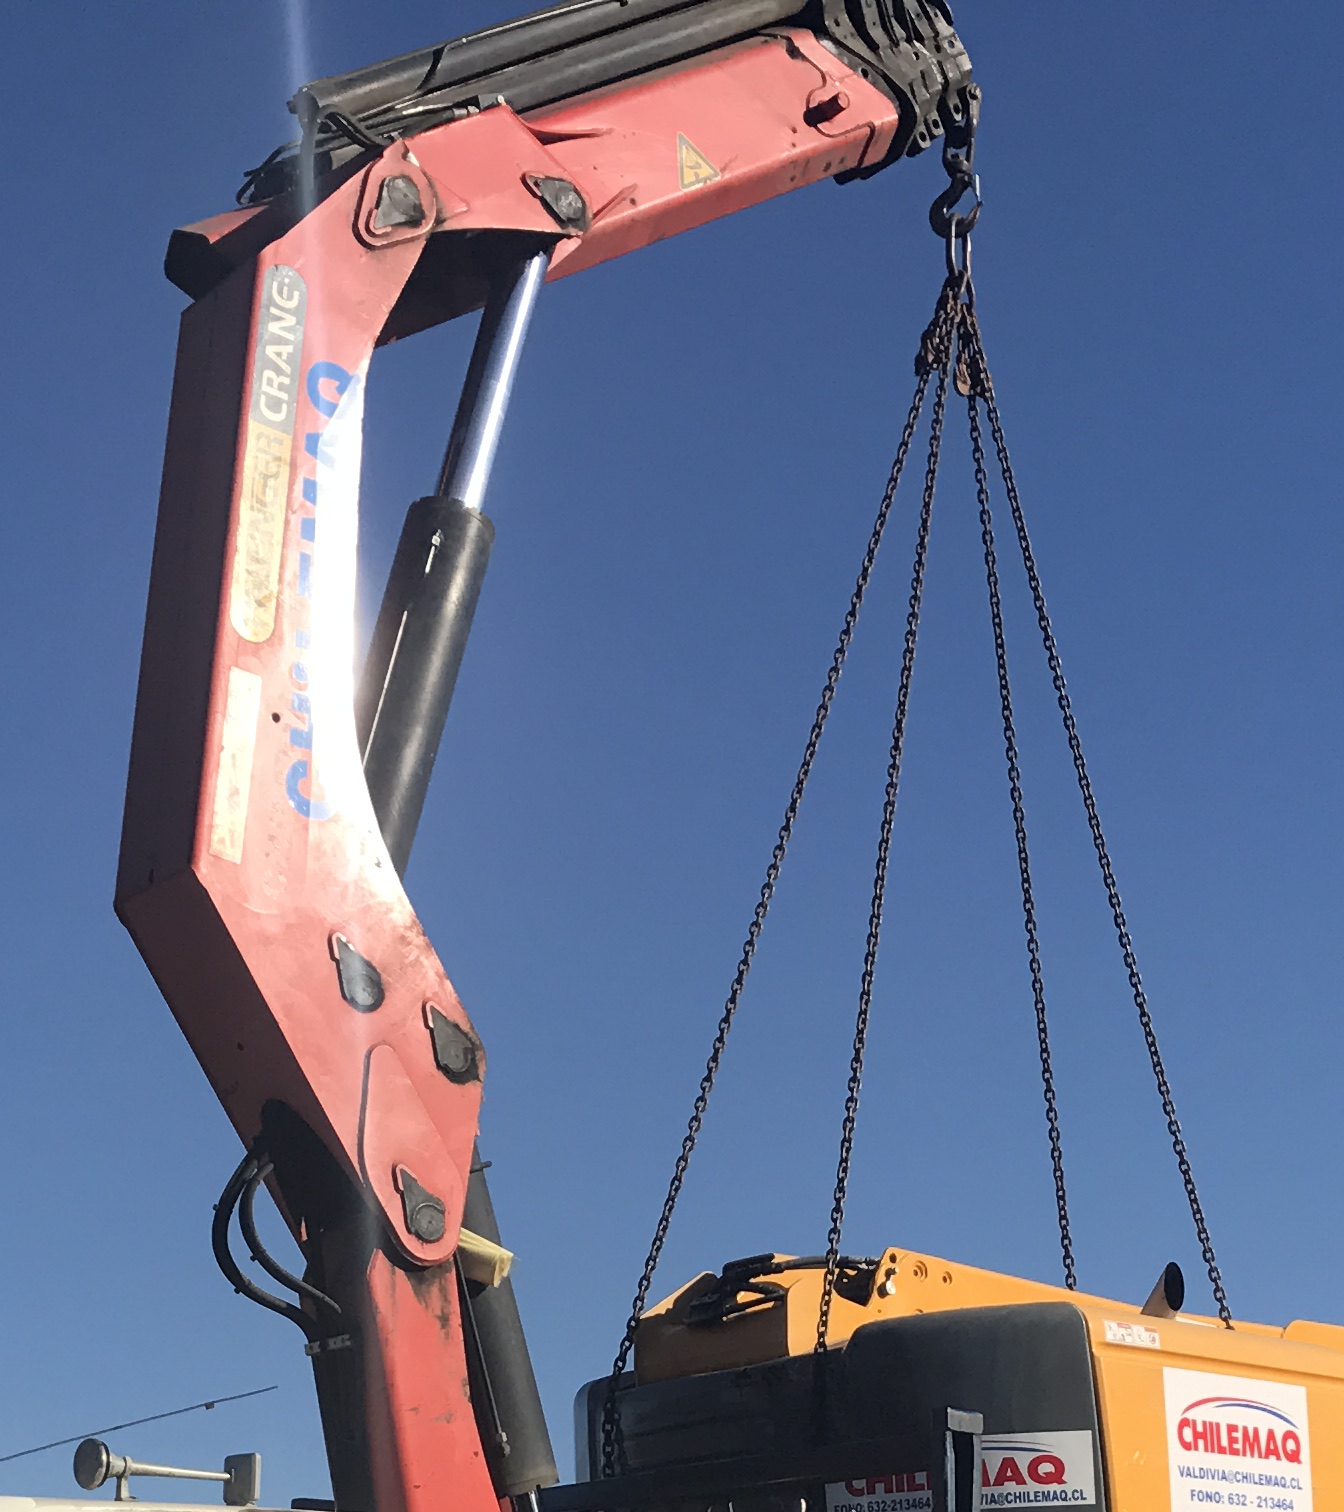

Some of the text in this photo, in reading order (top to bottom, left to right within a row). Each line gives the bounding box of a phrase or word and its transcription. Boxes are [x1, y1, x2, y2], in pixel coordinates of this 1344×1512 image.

[259, 279, 300, 422] CRANE
[1176, 1416, 1303, 1465] CHILEMAQ
[1177, 1464, 1304, 1491] VALDIVIA@CHILEMAQ.CL
[1190, 1488, 1225, 1505] FONO:
[1227, 1492, 1248, 1507] 632
[1256, 1495, 1294, 1512] 213464
